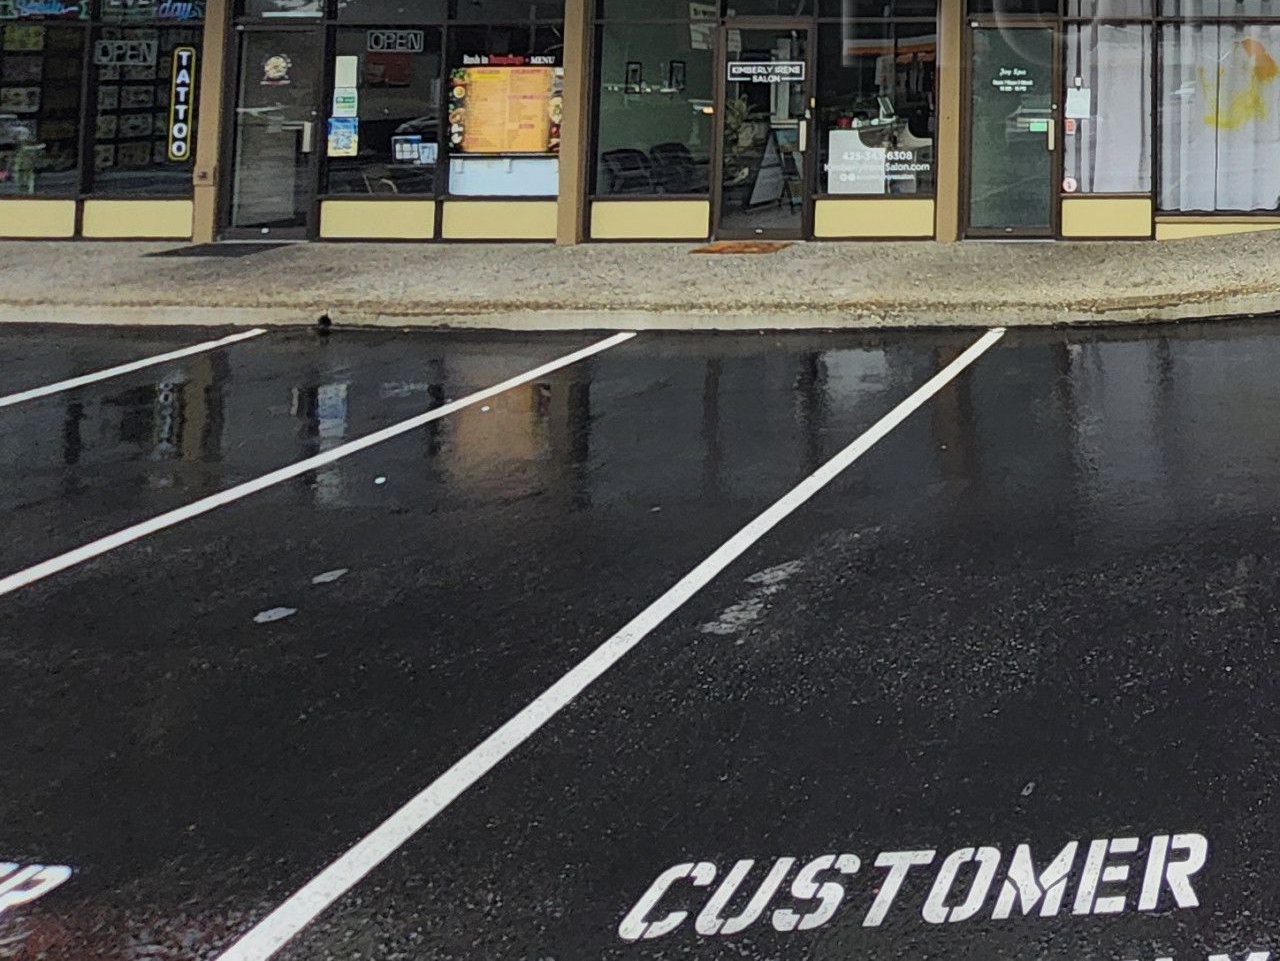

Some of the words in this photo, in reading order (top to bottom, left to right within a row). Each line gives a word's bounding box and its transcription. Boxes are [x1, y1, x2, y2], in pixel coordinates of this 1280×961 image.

[370, 31, 421, 50] OPEN
[99, 43, 156, 64] OPEN
[530, 55, 555, 65] MENU
[731, 65, 773, 75] KIMBERLY
[774, 65, 801, 75] IRENE
[752, 74, 781, 84] SALON
[171, 51, 192, 157] TATTOO
[618, 833, 1208, 940] CUSTOMER
